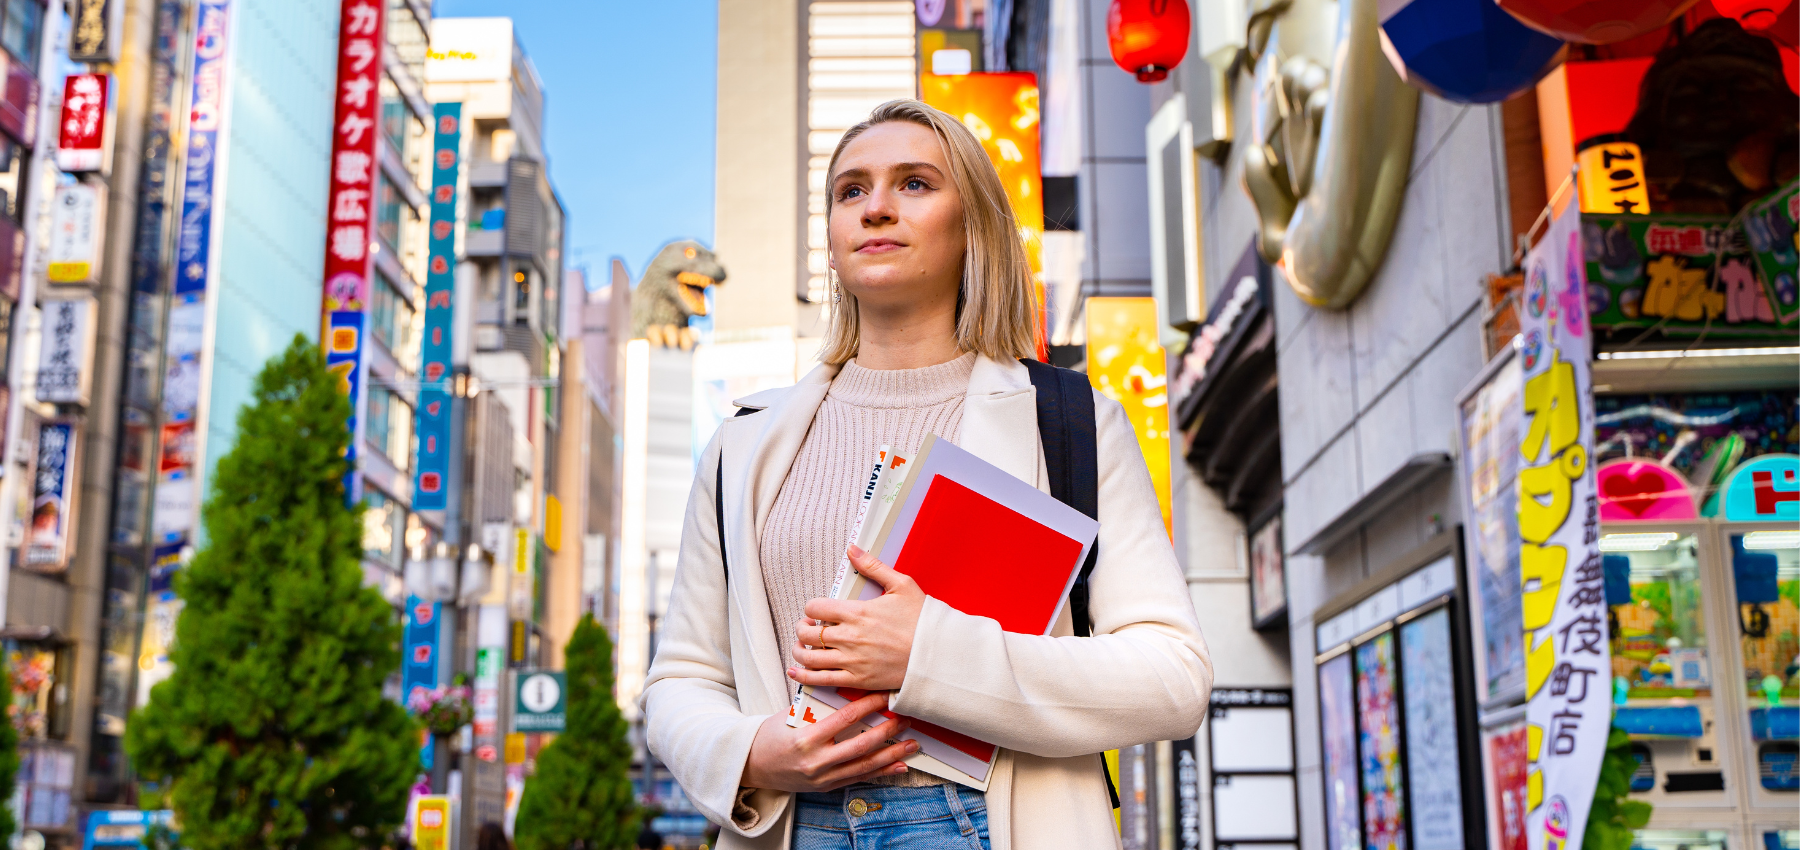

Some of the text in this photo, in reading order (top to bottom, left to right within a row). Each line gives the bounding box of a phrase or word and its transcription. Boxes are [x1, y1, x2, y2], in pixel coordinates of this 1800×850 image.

[331, 3, 378, 261] カラオケ歌広場
[862, 463, 883, 501] KANJI
[847, 529, 860, 545] AN
